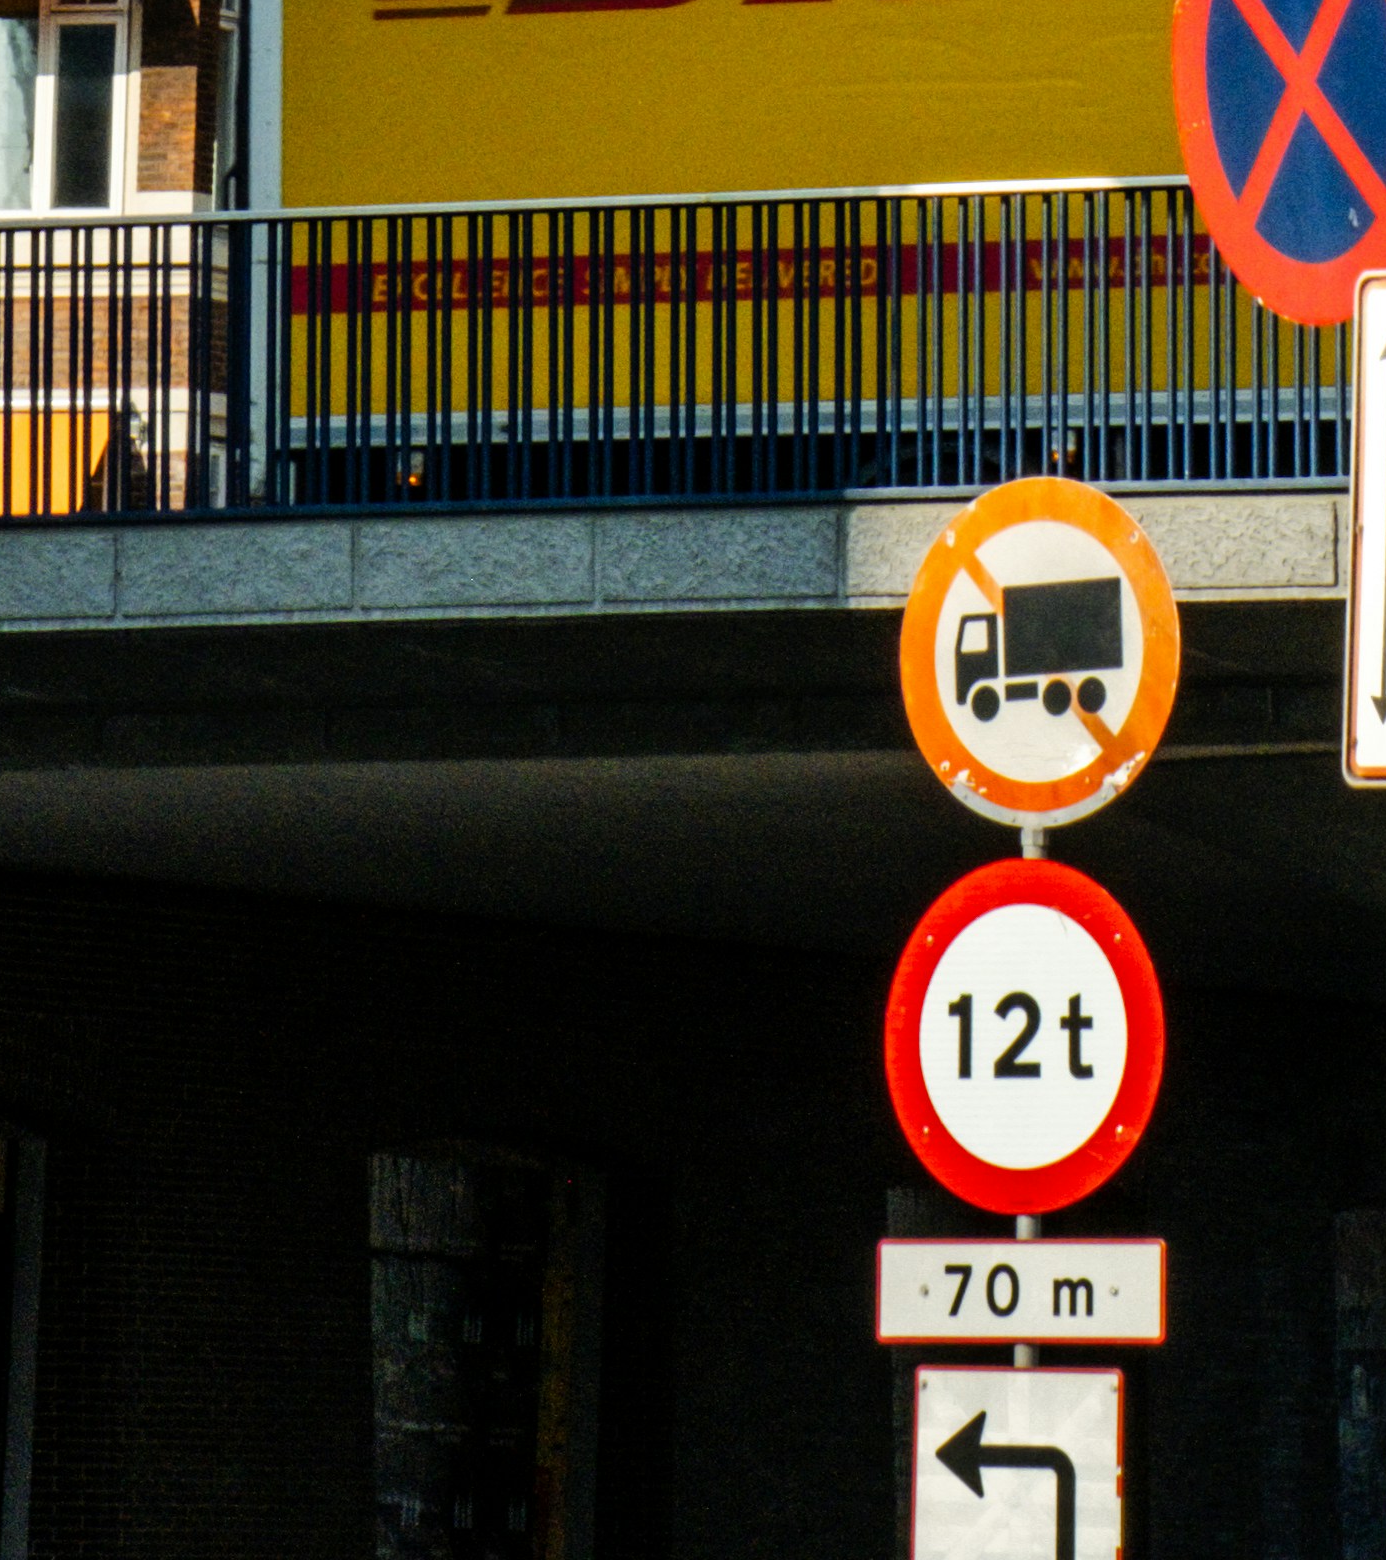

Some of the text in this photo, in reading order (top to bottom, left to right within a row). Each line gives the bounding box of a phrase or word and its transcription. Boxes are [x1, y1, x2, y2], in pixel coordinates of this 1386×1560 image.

[371, 268, 566, 302] ECLEC
[705, 257, 879, 291] DEVRD
[944, 1263, 1094, 1317] 70 m
